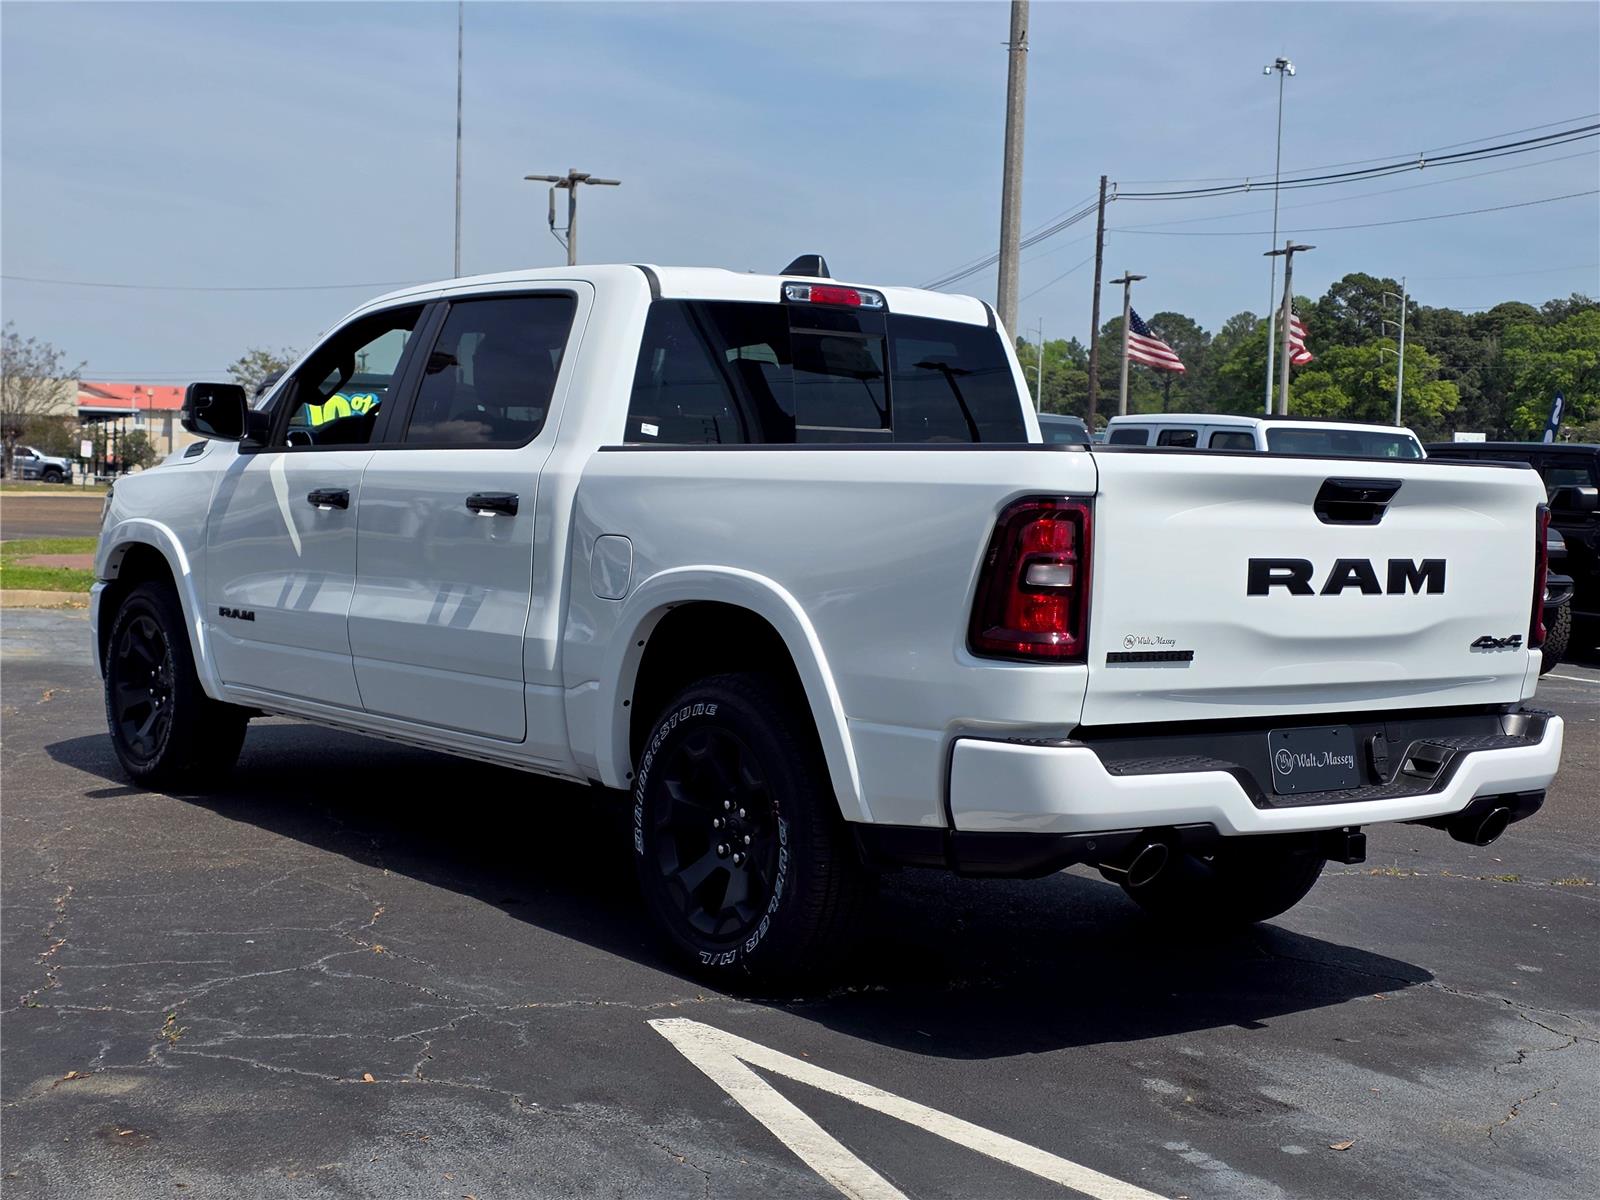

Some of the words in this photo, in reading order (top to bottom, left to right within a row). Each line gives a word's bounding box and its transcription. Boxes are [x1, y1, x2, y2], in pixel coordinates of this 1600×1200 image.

[1247, 557, 1446, 596] RAM
[218, 606, 255, 621] RAM
[1134, 636, 1150, 645] Walt
[1151, 635, 1176, 647] Massey
[1470, 634, 1523, 650] 4x4
[1293, 753, 1317, 768] Walt
[1316, 751, 1354, 769] Massey
